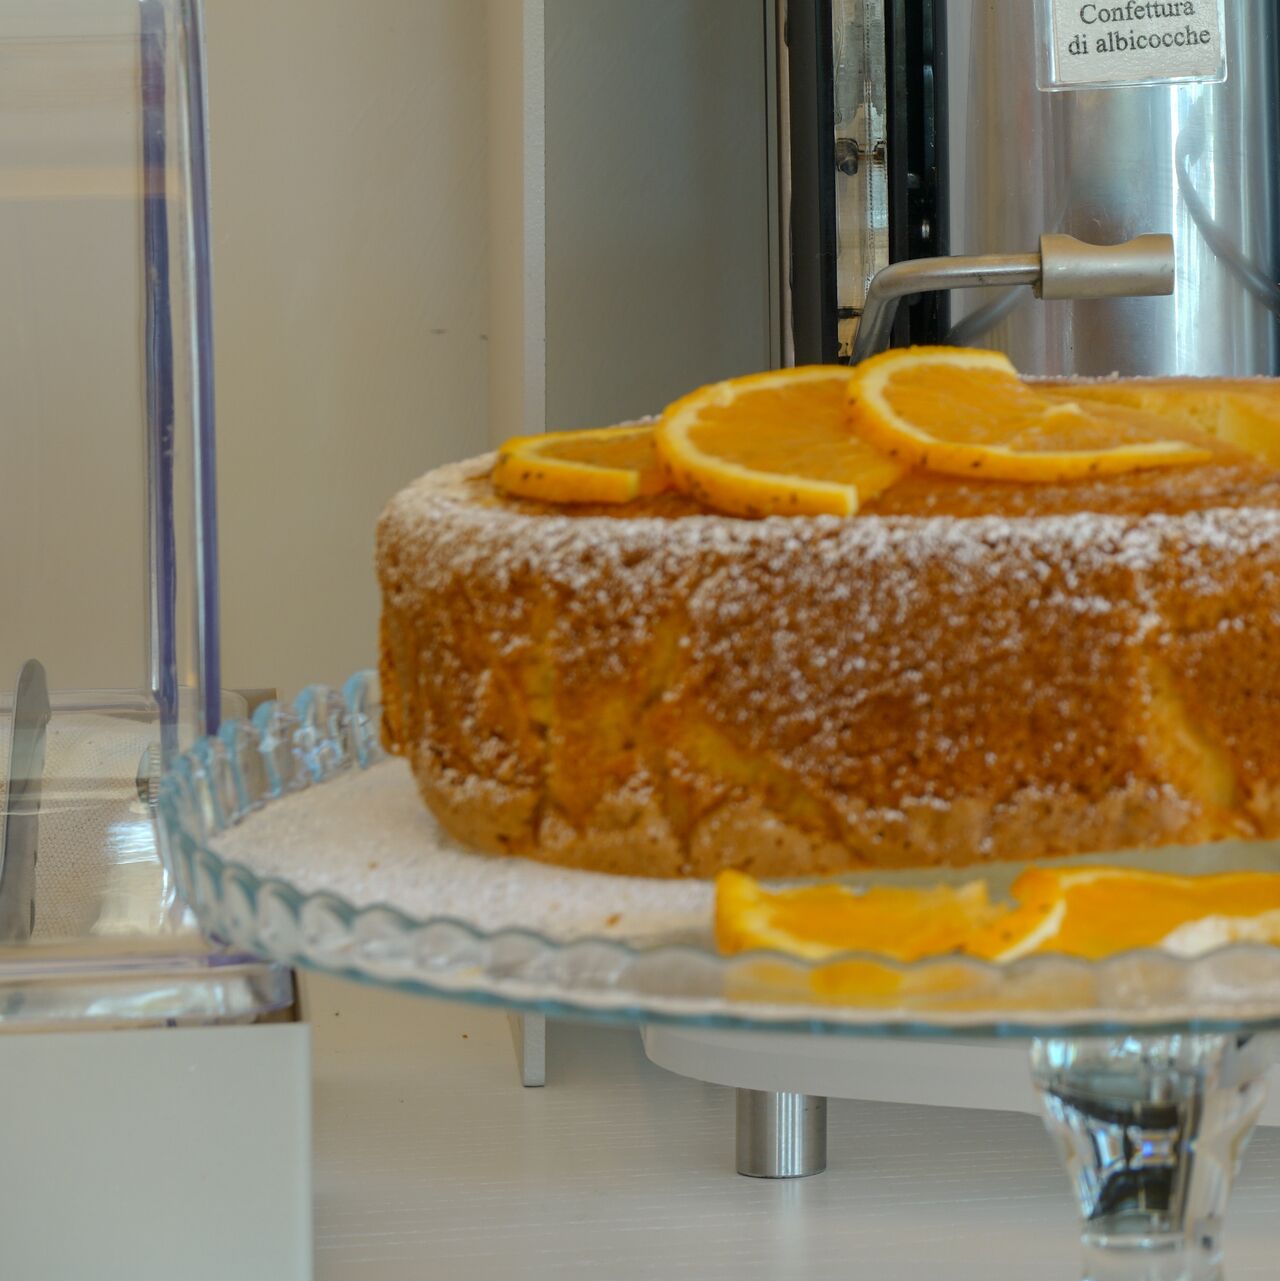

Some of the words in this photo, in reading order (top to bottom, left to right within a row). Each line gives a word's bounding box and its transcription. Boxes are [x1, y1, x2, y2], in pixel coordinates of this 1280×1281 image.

[1080, 0, 1195, 24] Confettura
[1068, 33, 1089, 56] di
[1096, 25, 1211, 53] albicocche
